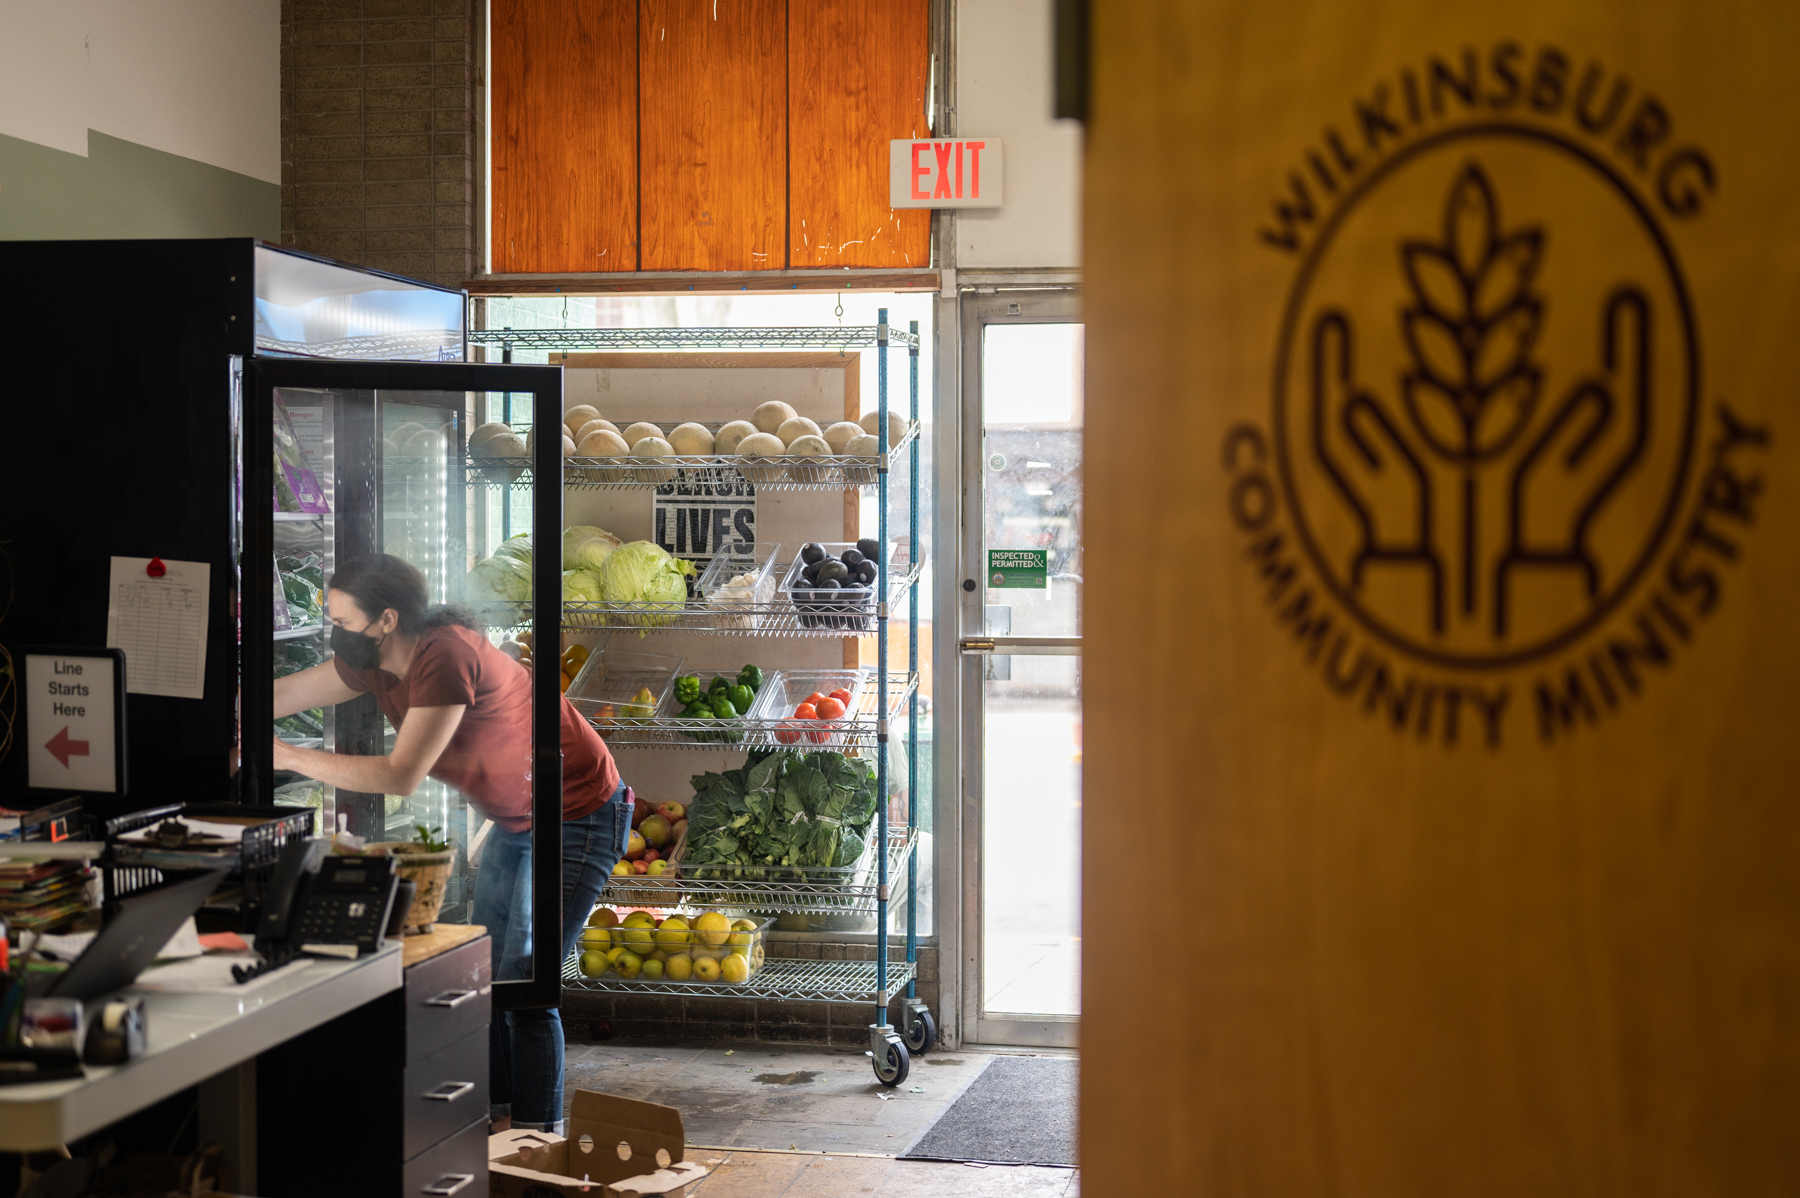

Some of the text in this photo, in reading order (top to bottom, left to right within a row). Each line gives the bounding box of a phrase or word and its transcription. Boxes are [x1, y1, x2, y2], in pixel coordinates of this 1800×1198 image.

[1261, 42, 1717, 256] WILKINSBURG
[911, 141, 985, 200] EXIT
[656, 508, 755, 554] LIVES
[991, 552, 1034, 560] INSPECTED
[991, 560, 1034, 568] PERMITTED
[1221, 403, 1771, 751] COMMUNITY MINISTRY
[54, 661, 83, 675] Line
[48, 681, 90, 697] Starts
[53, 702, 86, 717] Here
